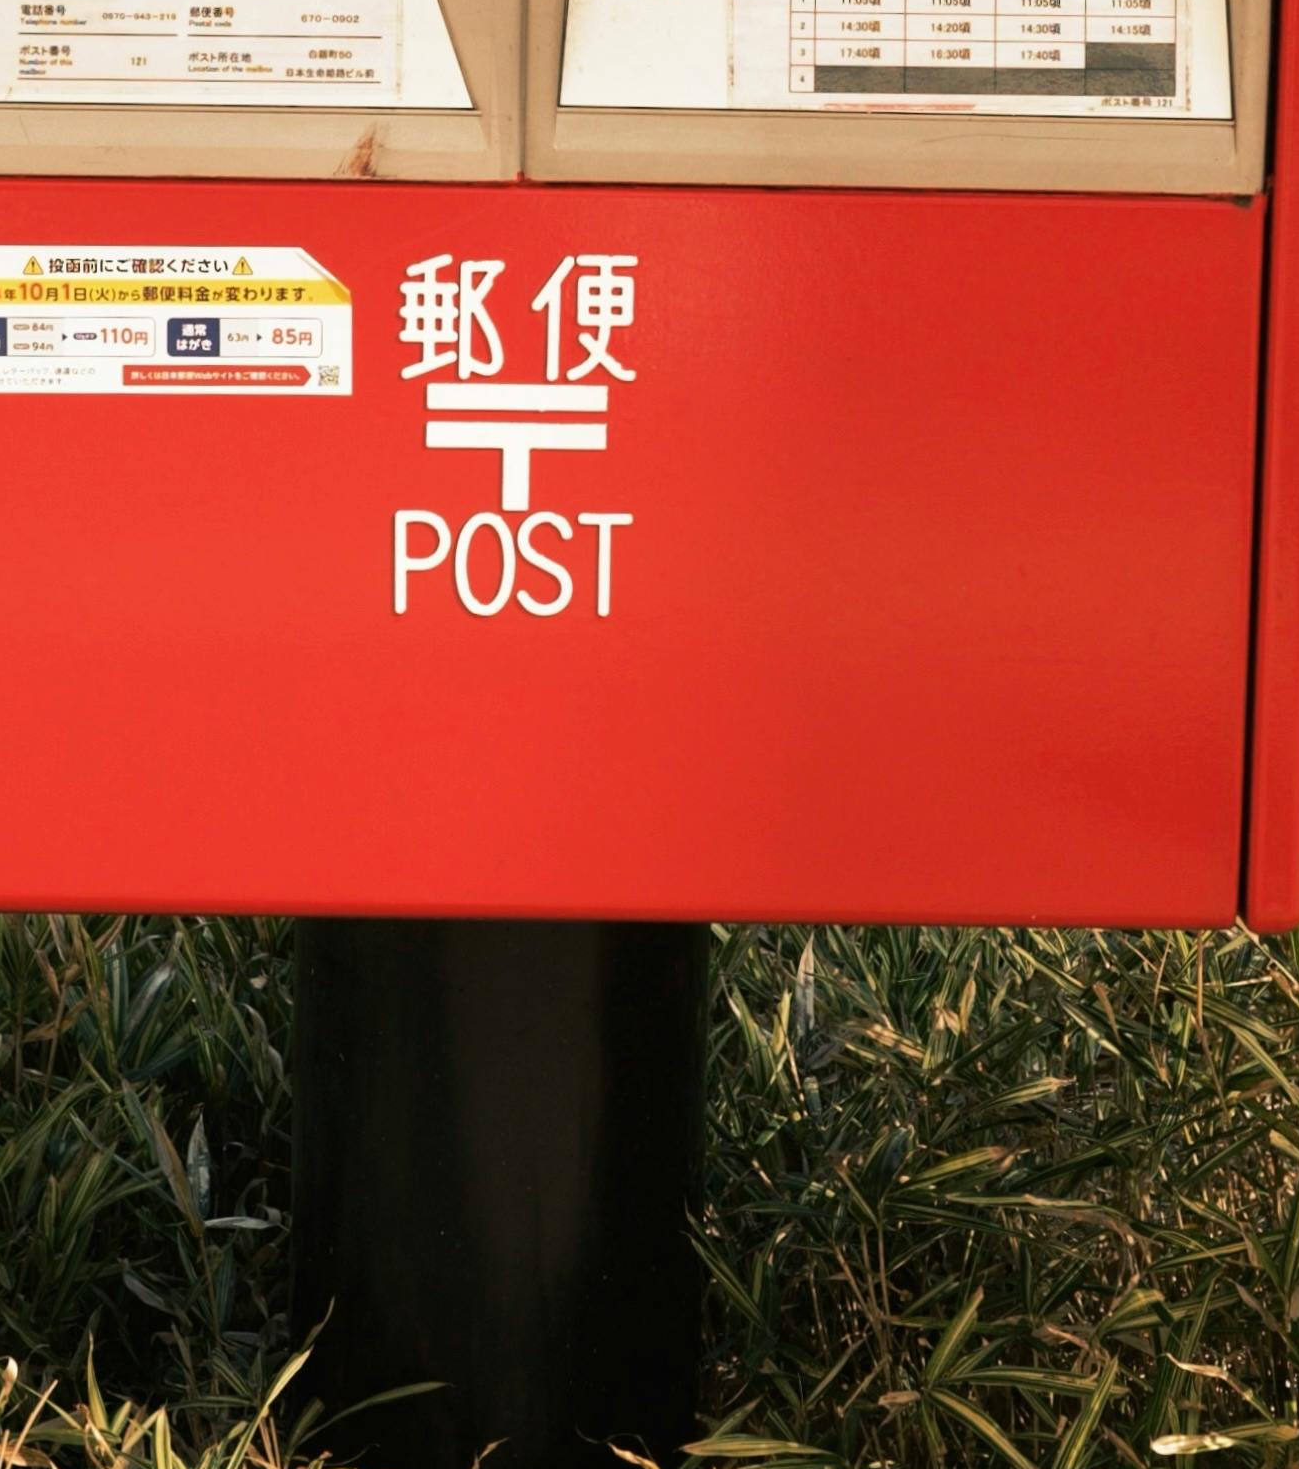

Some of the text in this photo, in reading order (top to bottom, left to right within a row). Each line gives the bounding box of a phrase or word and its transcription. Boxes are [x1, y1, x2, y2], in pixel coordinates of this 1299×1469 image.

[21, 4, 66, 16] 電話番号
[190, 6, 234, 18] 郵便番号
[189, 52, 252, 63] ポスト所在地
[48, 258, 229, 274] 投函前にご確認ください
[399, 254, 638, 382] 郵便
[100, 327, 148, 345] 110円
[271, 328, 313, 346] 85円
[393, 510, 633, 617] POST
